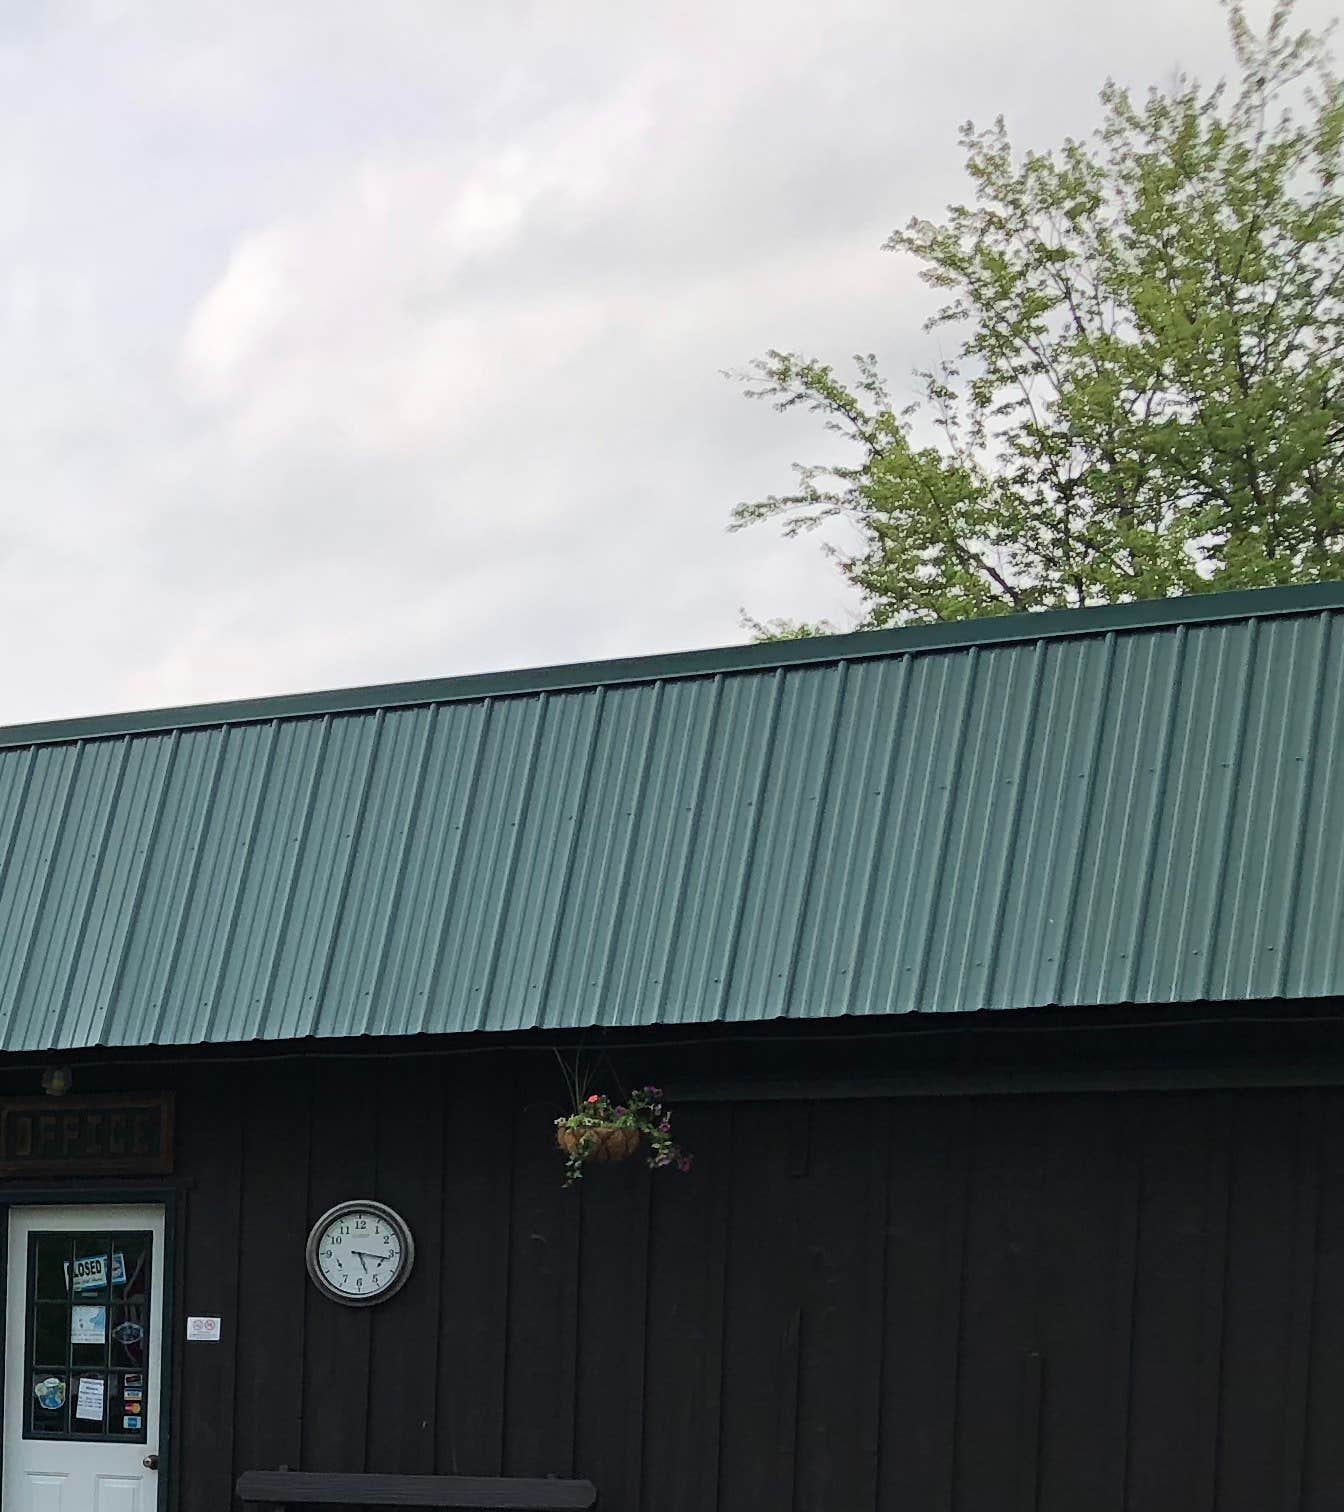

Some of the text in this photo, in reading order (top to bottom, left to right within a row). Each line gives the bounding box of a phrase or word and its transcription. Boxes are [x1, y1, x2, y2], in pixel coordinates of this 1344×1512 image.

[15, 1113, 152, 1156] OFFICE
[355, 1220, 367, 1230] 12
[340, 1226, 350, 1235] 11
[375, 1225, 380, 1235] 1
[331, 1236, 342, 1245] 10
[383, 1235, 390, 1245] 2
[326, 1249, 333, 1258] 9
[388, 1249, 395, 1258] 3
[343, 1274, 349, 1283] 7
[356, 1278, 363, 1287] 6
[372, 1274, 378, 1283] 5
